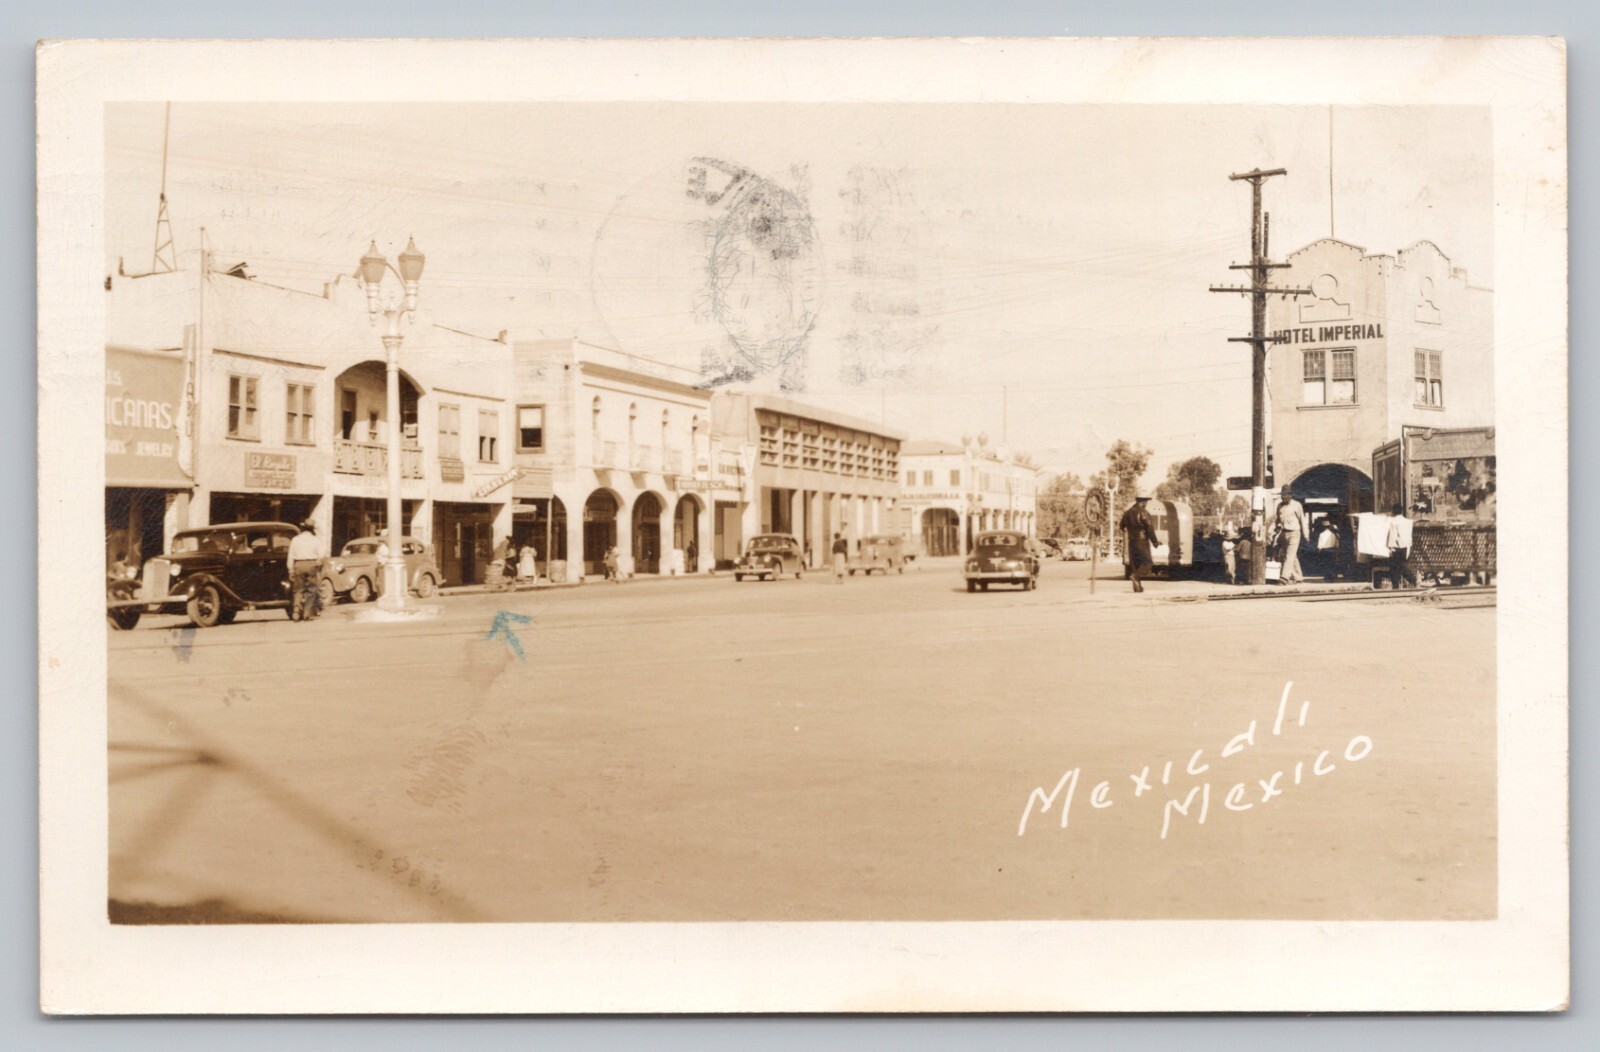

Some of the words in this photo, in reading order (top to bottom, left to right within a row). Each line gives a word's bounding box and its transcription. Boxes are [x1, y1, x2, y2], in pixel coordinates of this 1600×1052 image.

[1273, 327, 1316, 346] HOTEL
[1319, 323, 1384, 342] IMPERIAL
[135, 441, 174, 458] JEWELRY
